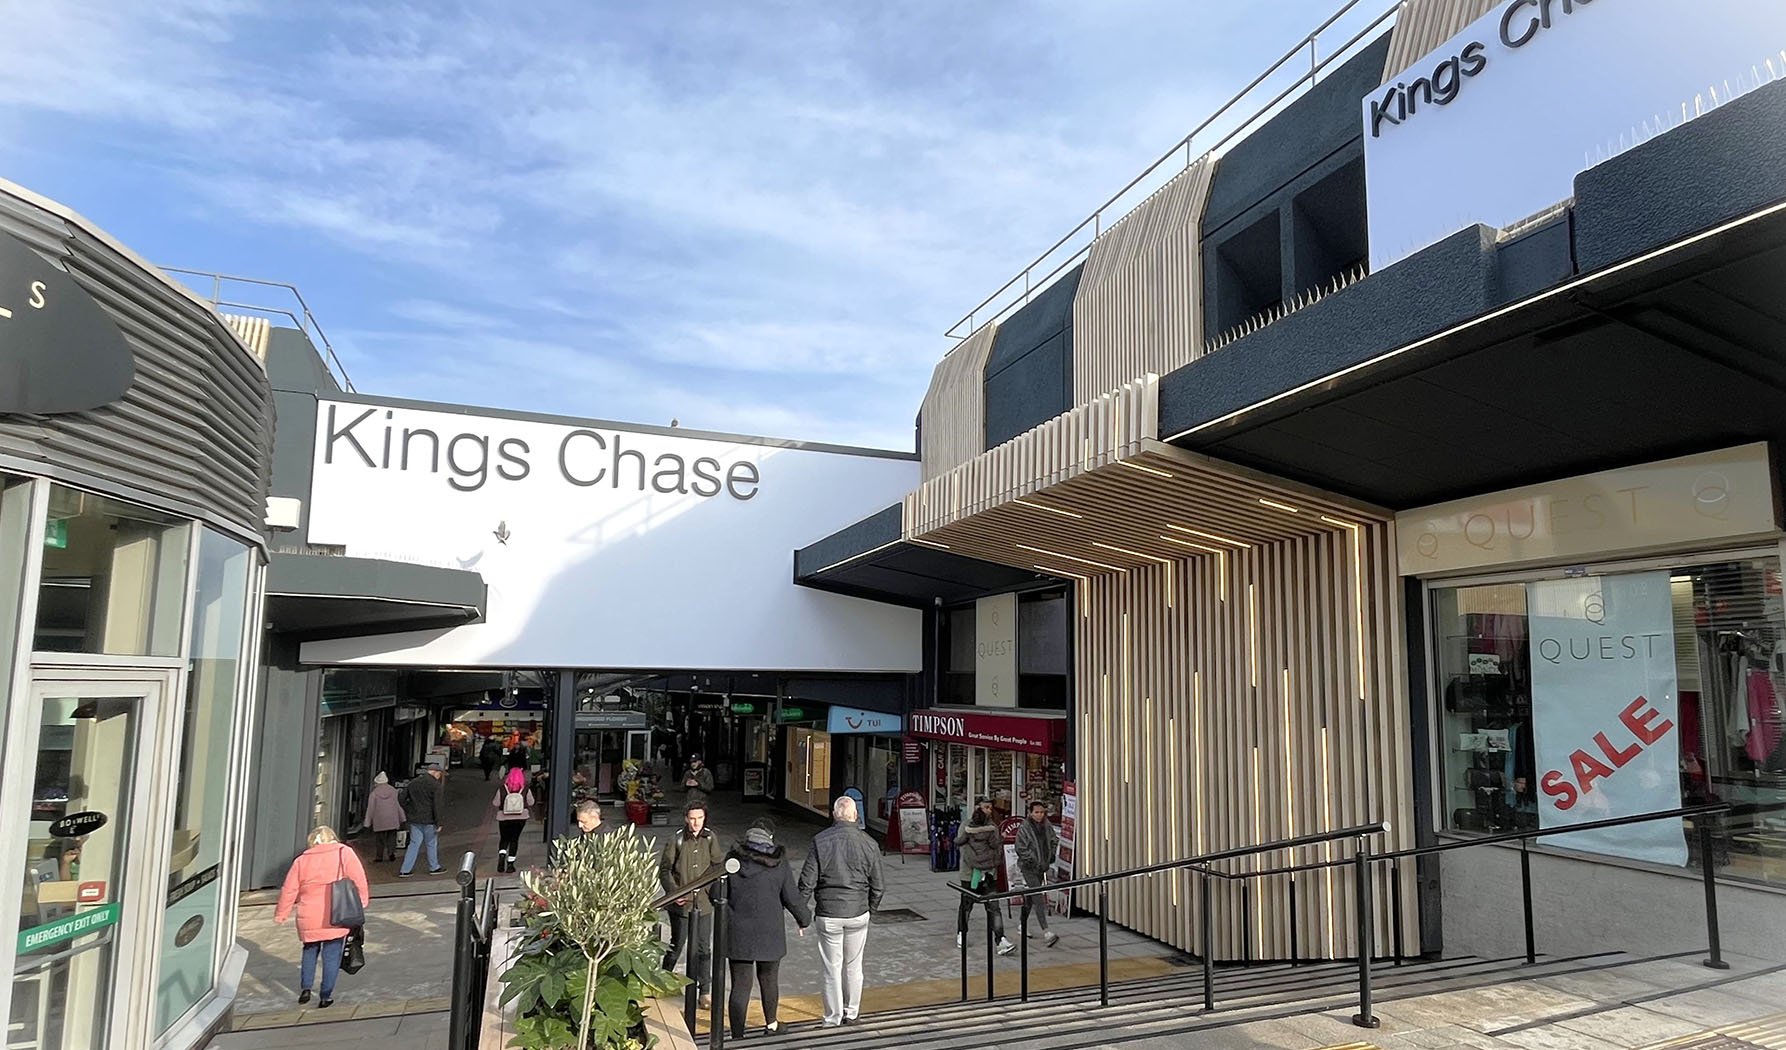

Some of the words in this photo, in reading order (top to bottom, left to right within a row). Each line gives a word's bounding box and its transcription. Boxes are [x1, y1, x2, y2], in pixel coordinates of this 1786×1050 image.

[1370, 40, 1487, 138] Kings
[324, 403, 531, 492] Kings
[558, 429, 760, 501] Chase
[1464, 485, 1647, 551] QUEST
[977, 639, 1013, 660] QUEST
[1539, 633, 1664, 664] QUEST
[912, 714, 965, 737] TIMPSON
[1012, 737, 1027, 745] People
[1540, 694, 1675, 811] SALE
[25, 920, 74, 948] EMERGENCY
[74, 915, 92, 931] EXIT
[91, 909, 110, 925] ONLY
